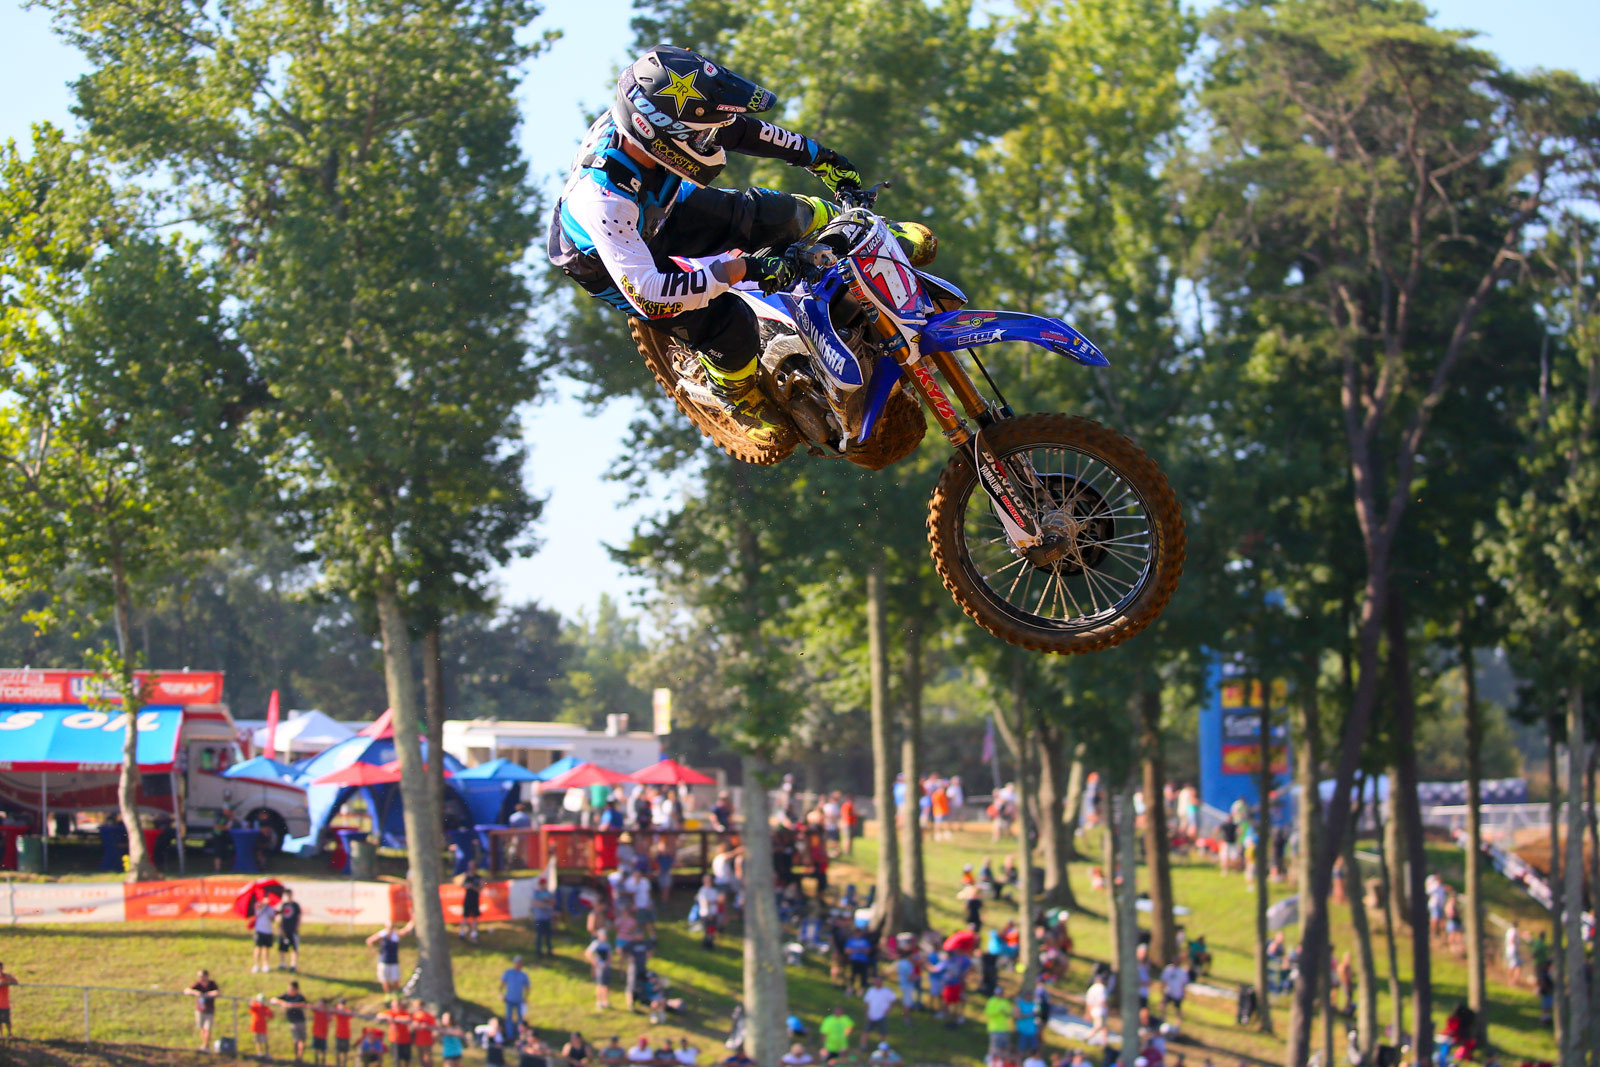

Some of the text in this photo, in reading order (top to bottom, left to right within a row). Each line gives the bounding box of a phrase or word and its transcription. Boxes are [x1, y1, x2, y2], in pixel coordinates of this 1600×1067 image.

[635, 116, 651, 137] BELL
[866, 233, 881, 253] LUCAS
[810, 321, 846, 375] YAMAHA
[914, 366, 956, 419] KYB
[980, 463, 1004, 496] YAMALUBE
[981, 451, 1032, 519] DUNLOP
[1000, 495, 1026, 528] BRAKING
